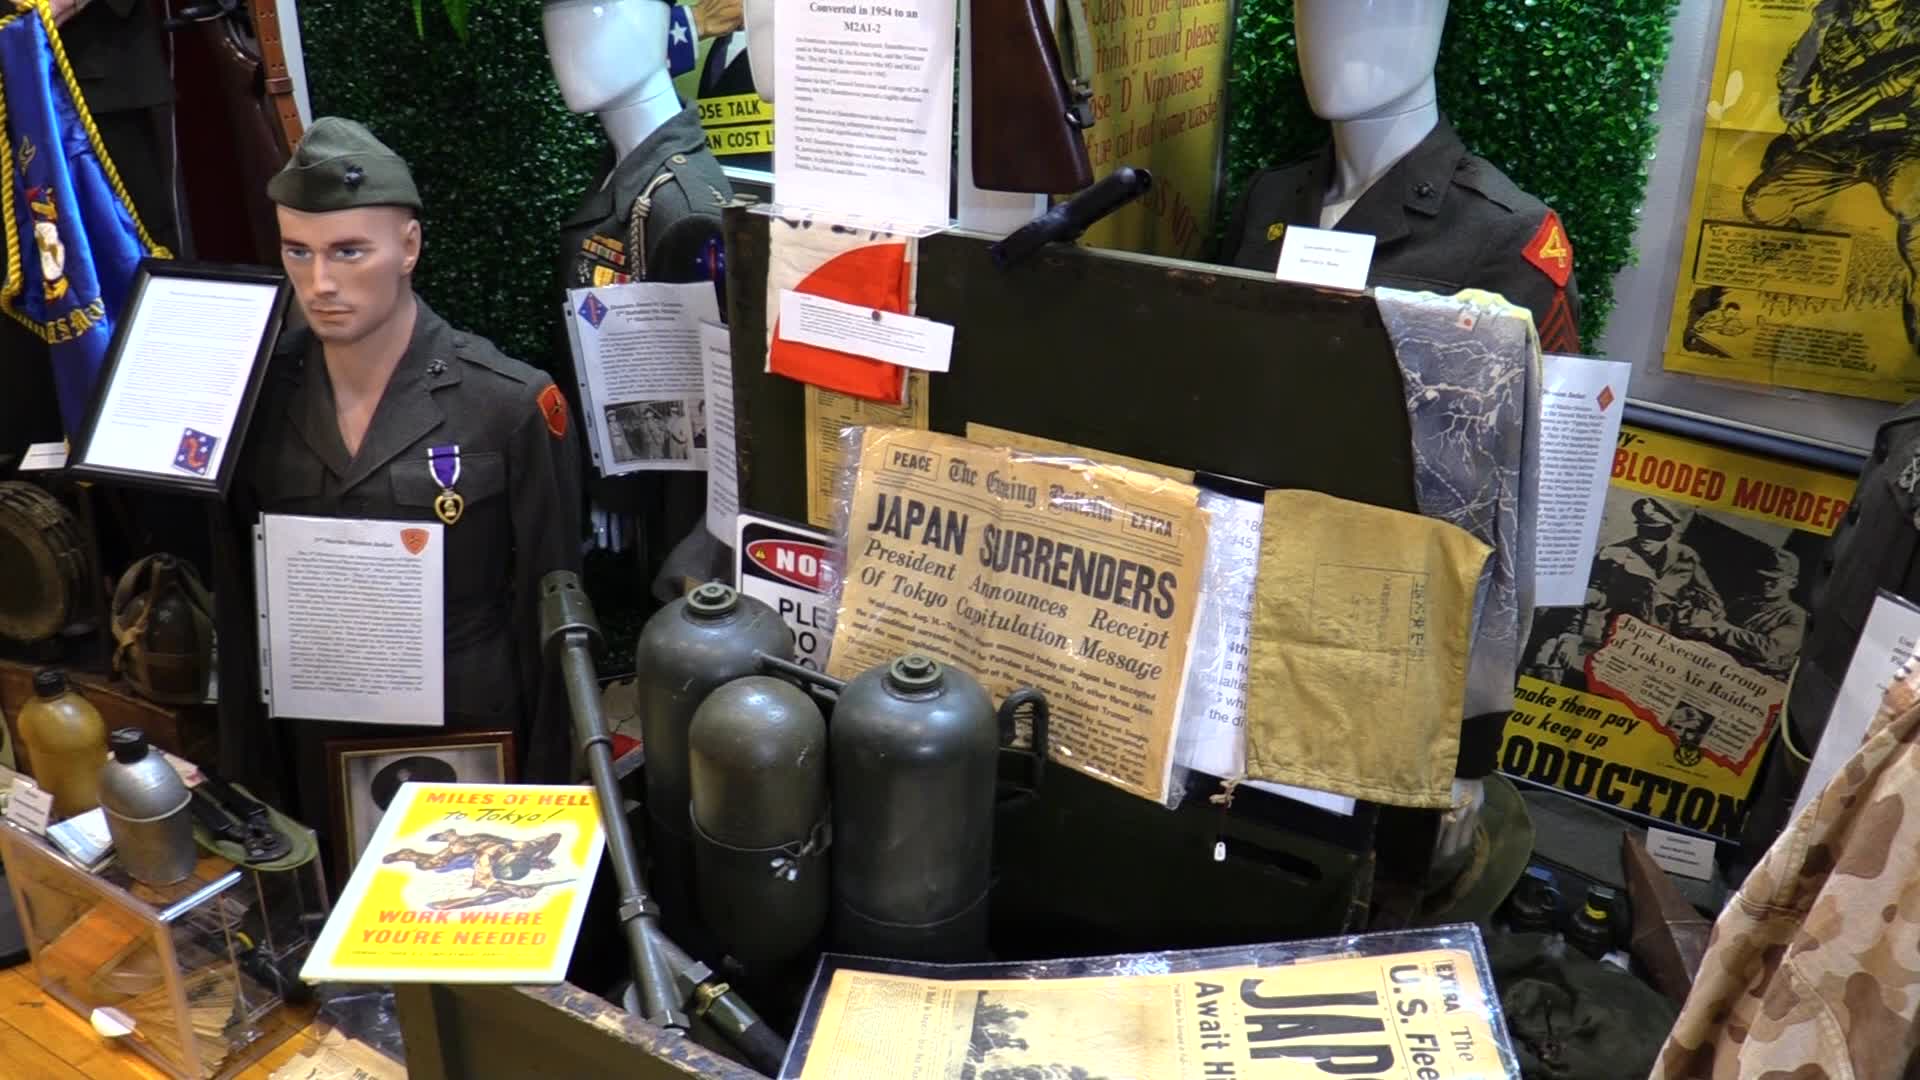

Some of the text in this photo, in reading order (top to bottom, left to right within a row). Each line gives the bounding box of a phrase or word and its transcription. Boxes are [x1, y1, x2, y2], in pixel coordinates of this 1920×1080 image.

[809, 2, 919, 19] Converted in 1954 to an
[843, 21, 881, 34] M2A1-2
[1184, 16, 1219, 61] please
[1143, 66, 1204, 104] Nipponese
[728, 99, 760, 116] TALK
[727, 130, 760, 148] COST
[1539, 226, 1568, 269] 4
[893, 450, 933, 473] PEACE
[949, 457, 979, 487] The
[1130, 511, 1173, 538] EXTRA
[1611, 448, 1850, 530] BLOODED MURDER
[867, 493, 969, 556] JAPAN
[979, 523, 1178, 620] SURRENDERS
[864, 537, 1171, 650] President Announces Receipt
[861, 565, 1162, 681] Of Tokyo Capitulation Message
[1610, 635, 1626, 650] of
[1631, 642, 1677, 676] Tokyo
[1680, 667, 1706, 690] Air
[1706, 681, 1765, 719] Raiders
[1618, 617, 1653, 641] Japs
[1655, 634, 1718, 670] Execute
[1719, 663, 1768, 697] Group
[1064, 693, 1099, 713] President
[1071, 680, 1085, 692] The
[1086, 688, 1107, 700] other
[1103, 677, 1117, 689] has
[1119, 684, 1157, 701] accepted
[1209, 708, 1229, 723] the
[1515, 687, 1641, 737] make them pay
[1537, 713, 1583, 742] keep
[1584, 730, 1609, 750] up
[425, 791, 592, 807] MILES OF HELL
[1497, 734, 1748, 837] ODUCTION
[444, 808, 565, 825] to Tokyo!
[362, 928, 548, 946] YOU'RE NEEDED
[378, 910, 545, 926] WORK WHERE
[1194, 981, 1231, 1050] Await
[1240, 978, 1396, 1080] JAP
[1434, 963, 1475, 1062] EXRA The
